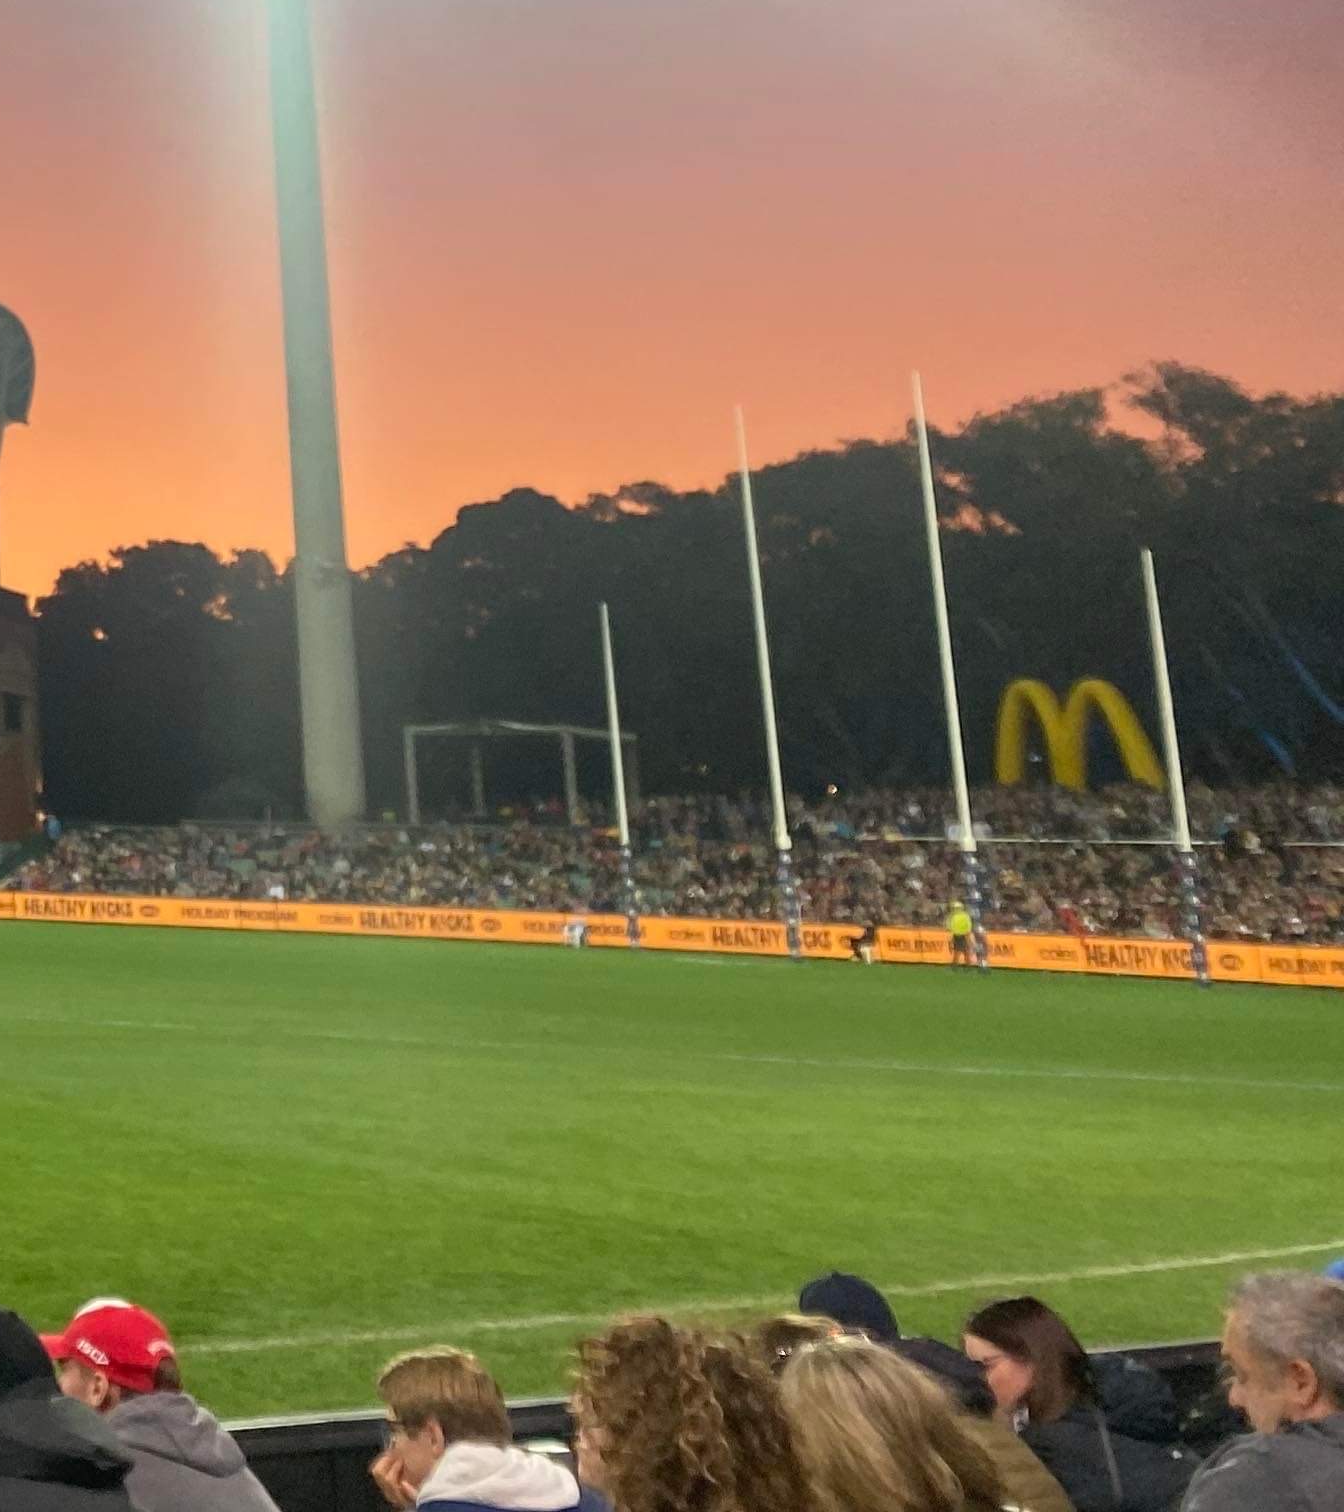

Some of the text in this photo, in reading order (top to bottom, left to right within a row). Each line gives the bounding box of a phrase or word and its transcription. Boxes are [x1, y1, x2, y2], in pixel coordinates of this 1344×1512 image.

[24, 899, 87, 917] HEALTHY
[90, 901, 134, 918] KICKS
[360, 912, 427, 930] HEALTHY
[429, 914, 474, 931] KICKS
[712, 928, 780, 947] HEALTHY
[1085, 943, 1158, 970] HEALTHY
[1267, 957, 1329, 975] HOLIDAY
